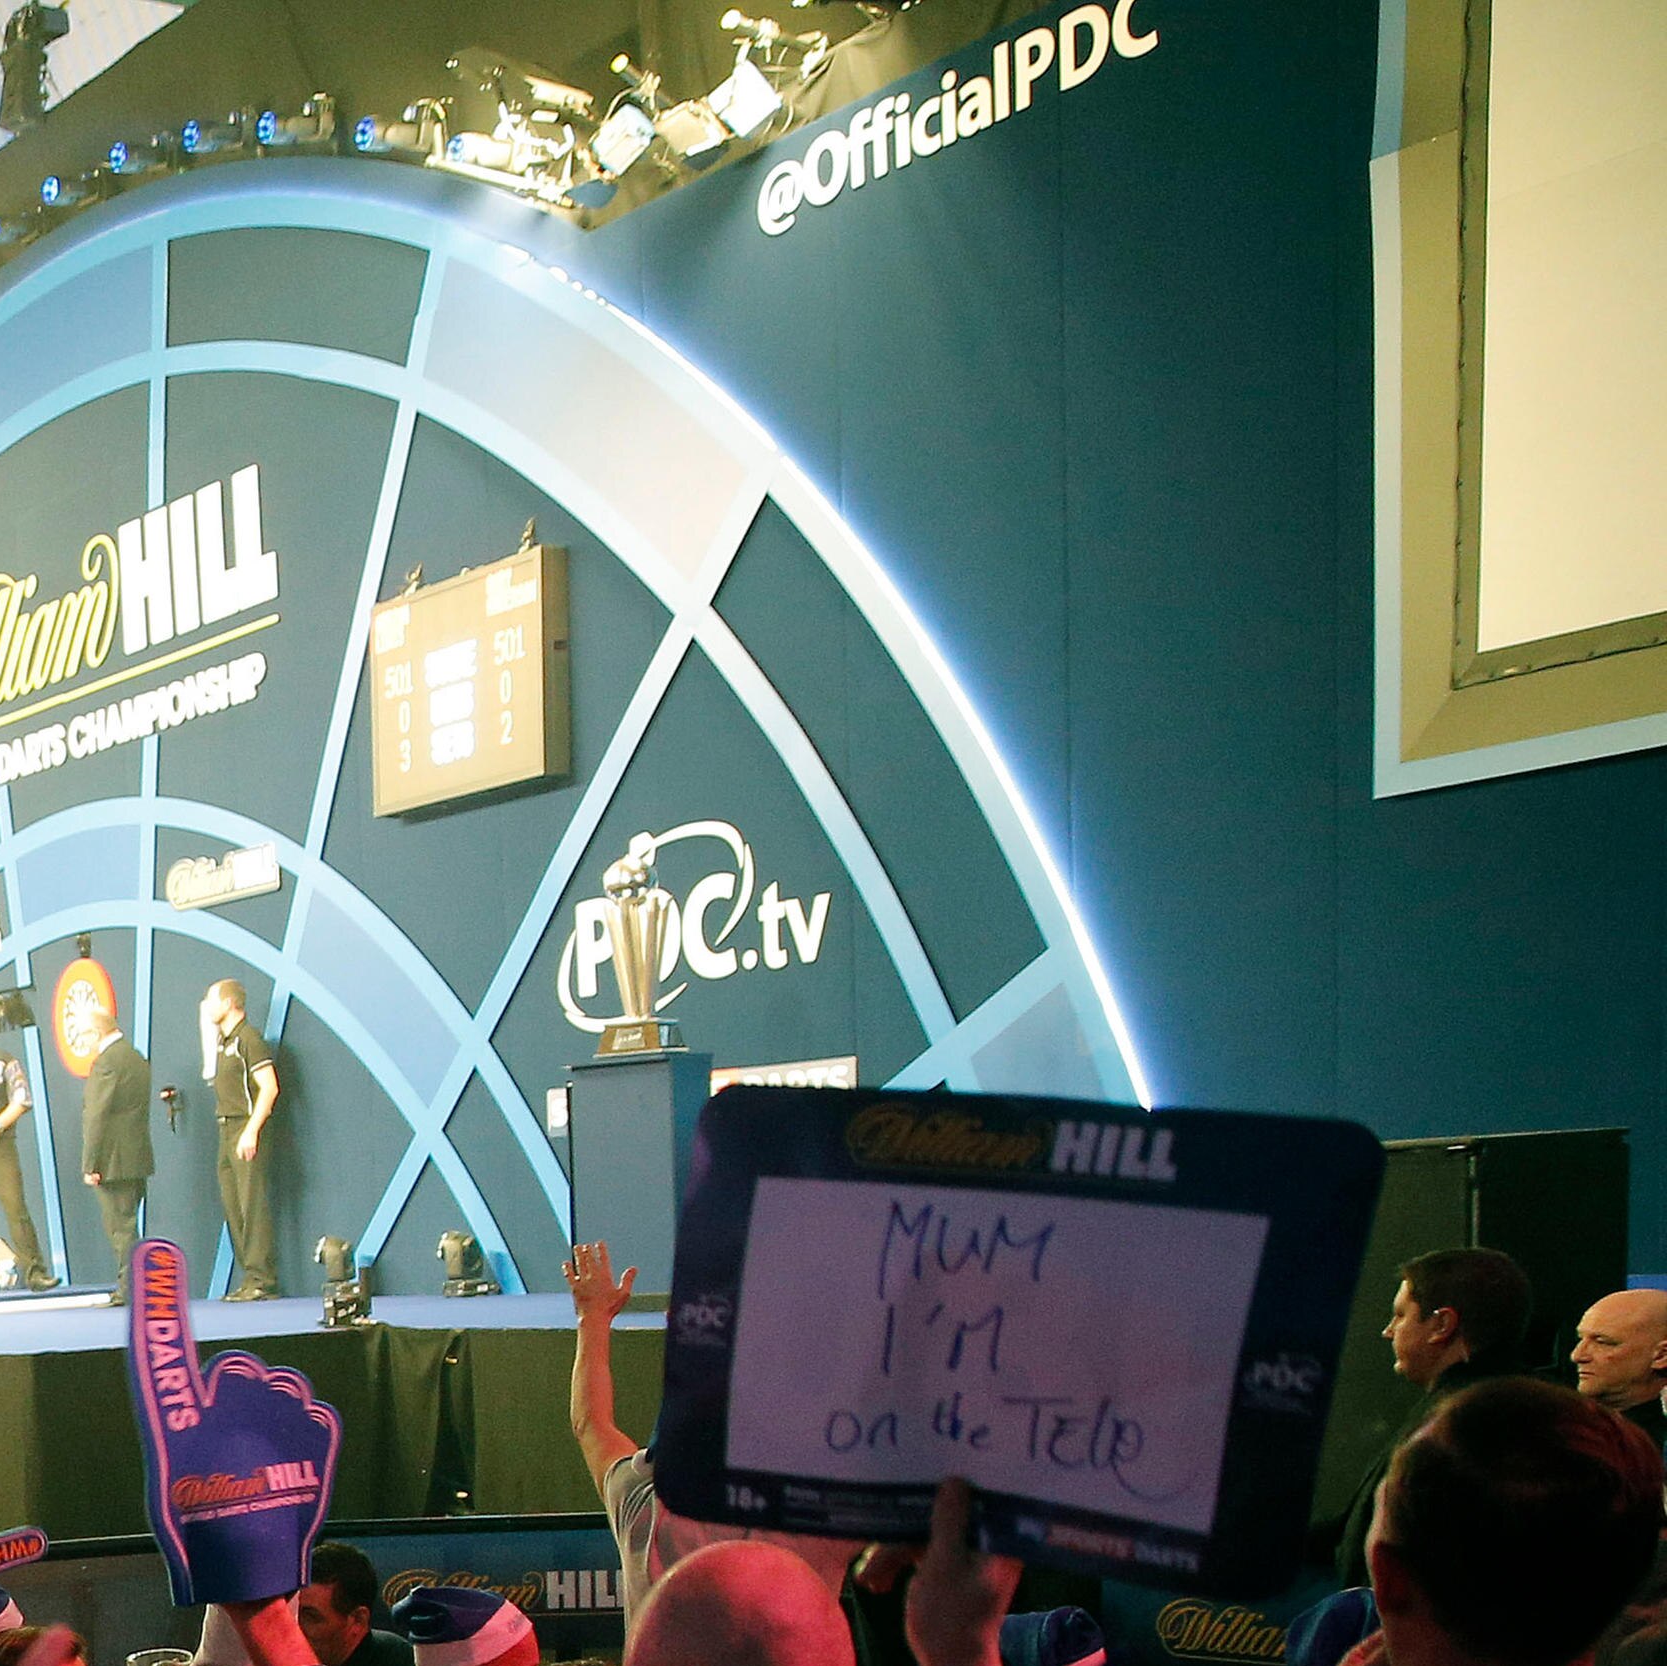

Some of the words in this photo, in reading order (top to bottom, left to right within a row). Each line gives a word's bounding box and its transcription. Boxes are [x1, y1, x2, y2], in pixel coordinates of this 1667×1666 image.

[756, 0, 1157, 235] @OfficialPDC
[117, 463, 279, 656] HILL
[494, 624, 525, 665] 501
[67, 652, 267, 759] CHAMPIONSHIP
[384, 662, 414, 699] 501
[400, 738, 411, 772] 3
[574, 872, 832, 998] PDC.tv
[1051, 1120, 1176, 1182] HILL
[878, 1200, 1058, 1300] MUM
[144, 1249, 201, 1433] #WHDARTS
[824, 1406, 897, 1453] on
[932, 1399, 992, 1451] the
[265, 1459, 320, 1490] HILL
[1156, 1598, 1287, 1657] Willia
